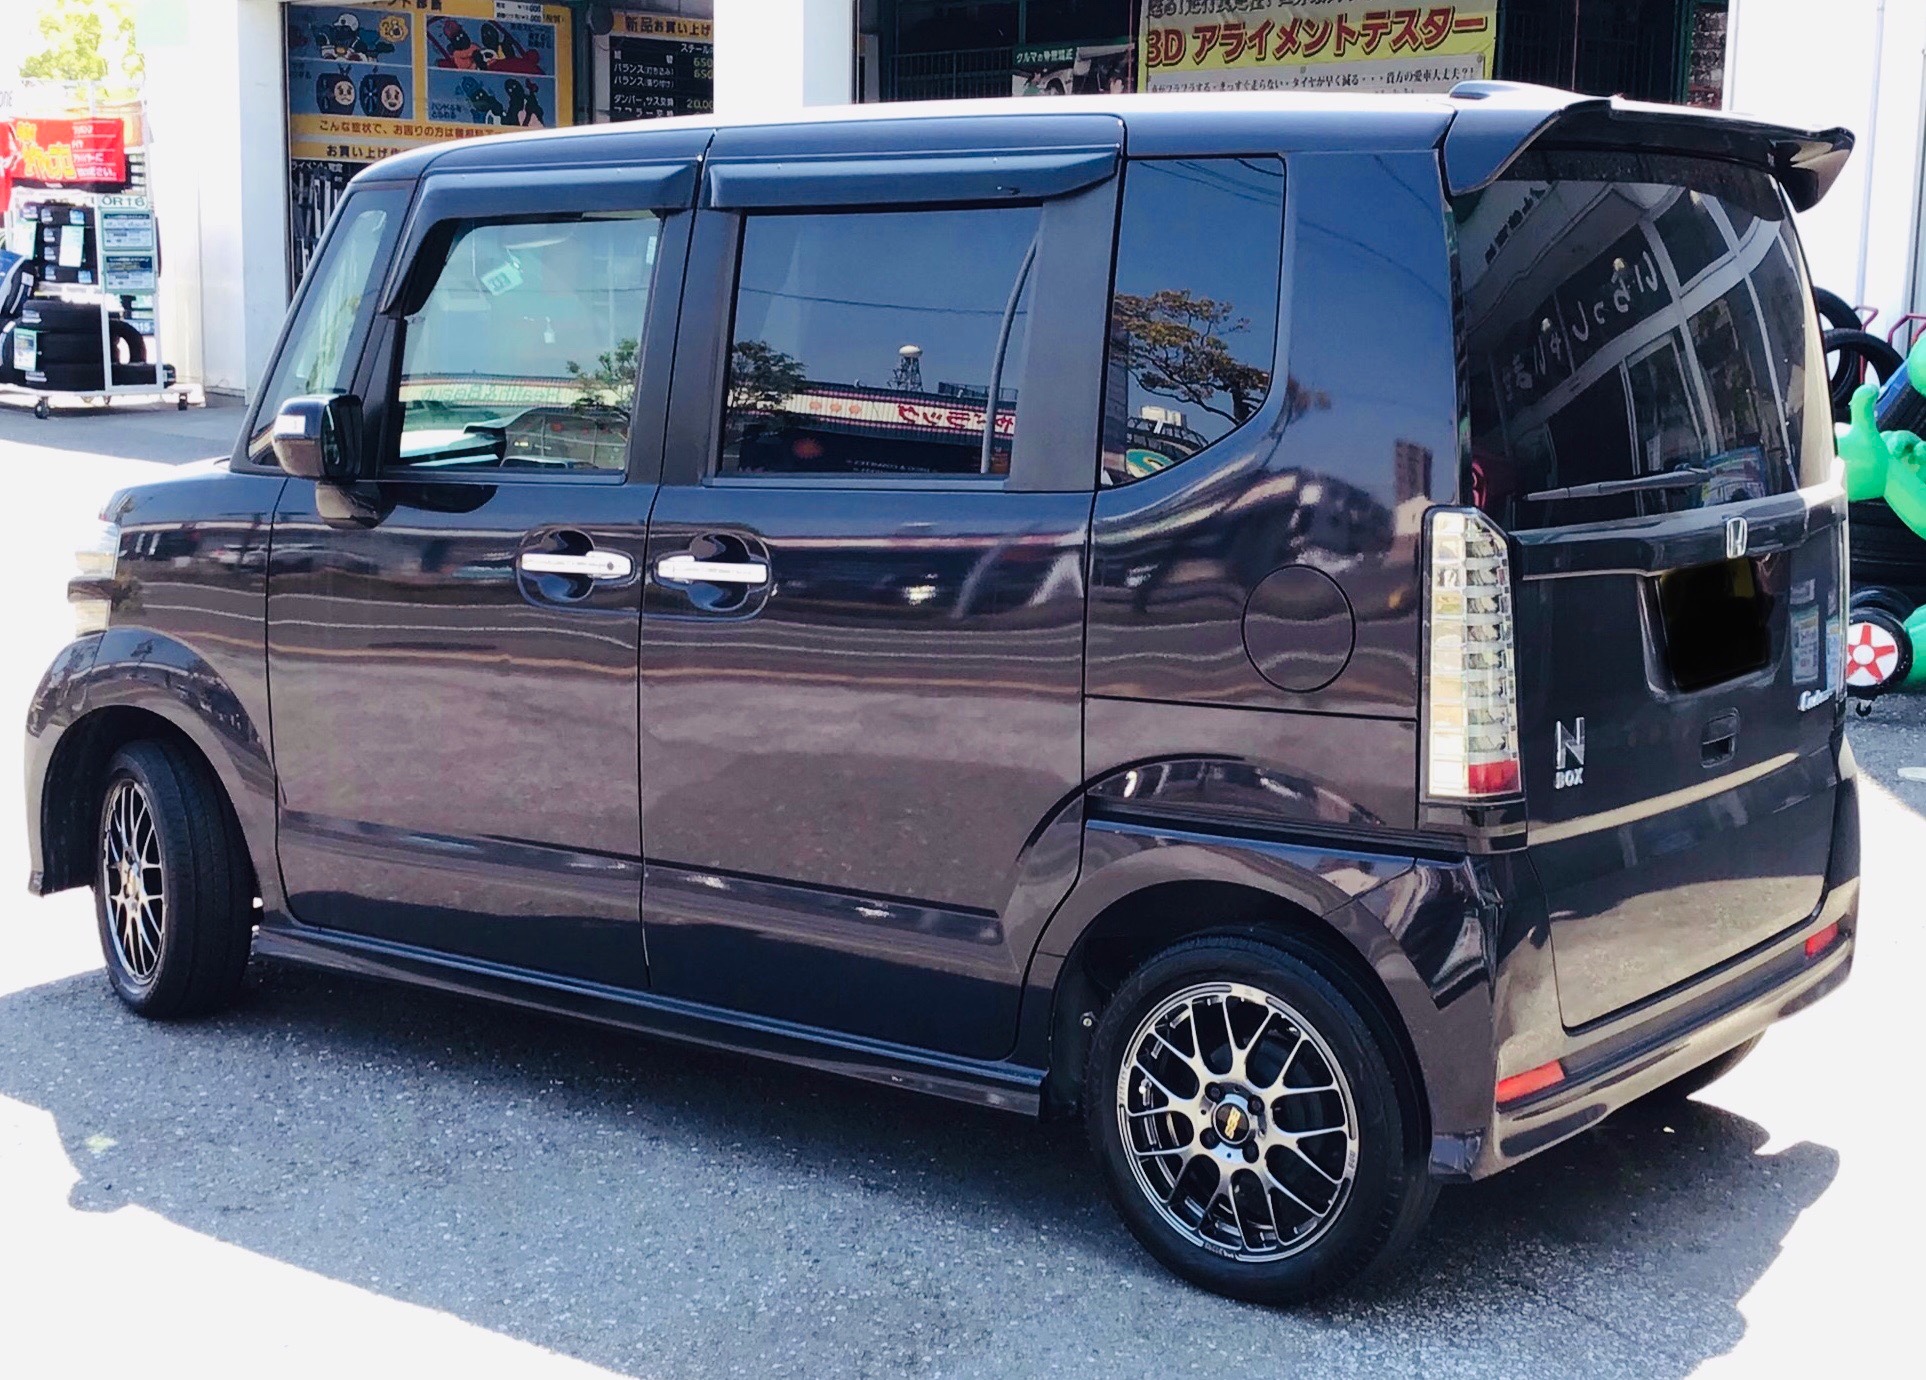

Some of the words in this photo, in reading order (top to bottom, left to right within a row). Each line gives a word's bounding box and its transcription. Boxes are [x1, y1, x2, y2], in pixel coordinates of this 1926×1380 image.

[1146, 27, 1187, 67] 3D
[1191, 6, 1488, 65] アライメントテスター
[1555, 716, 1586, 770] N
[1555, 767, 1584, 790] BOX
